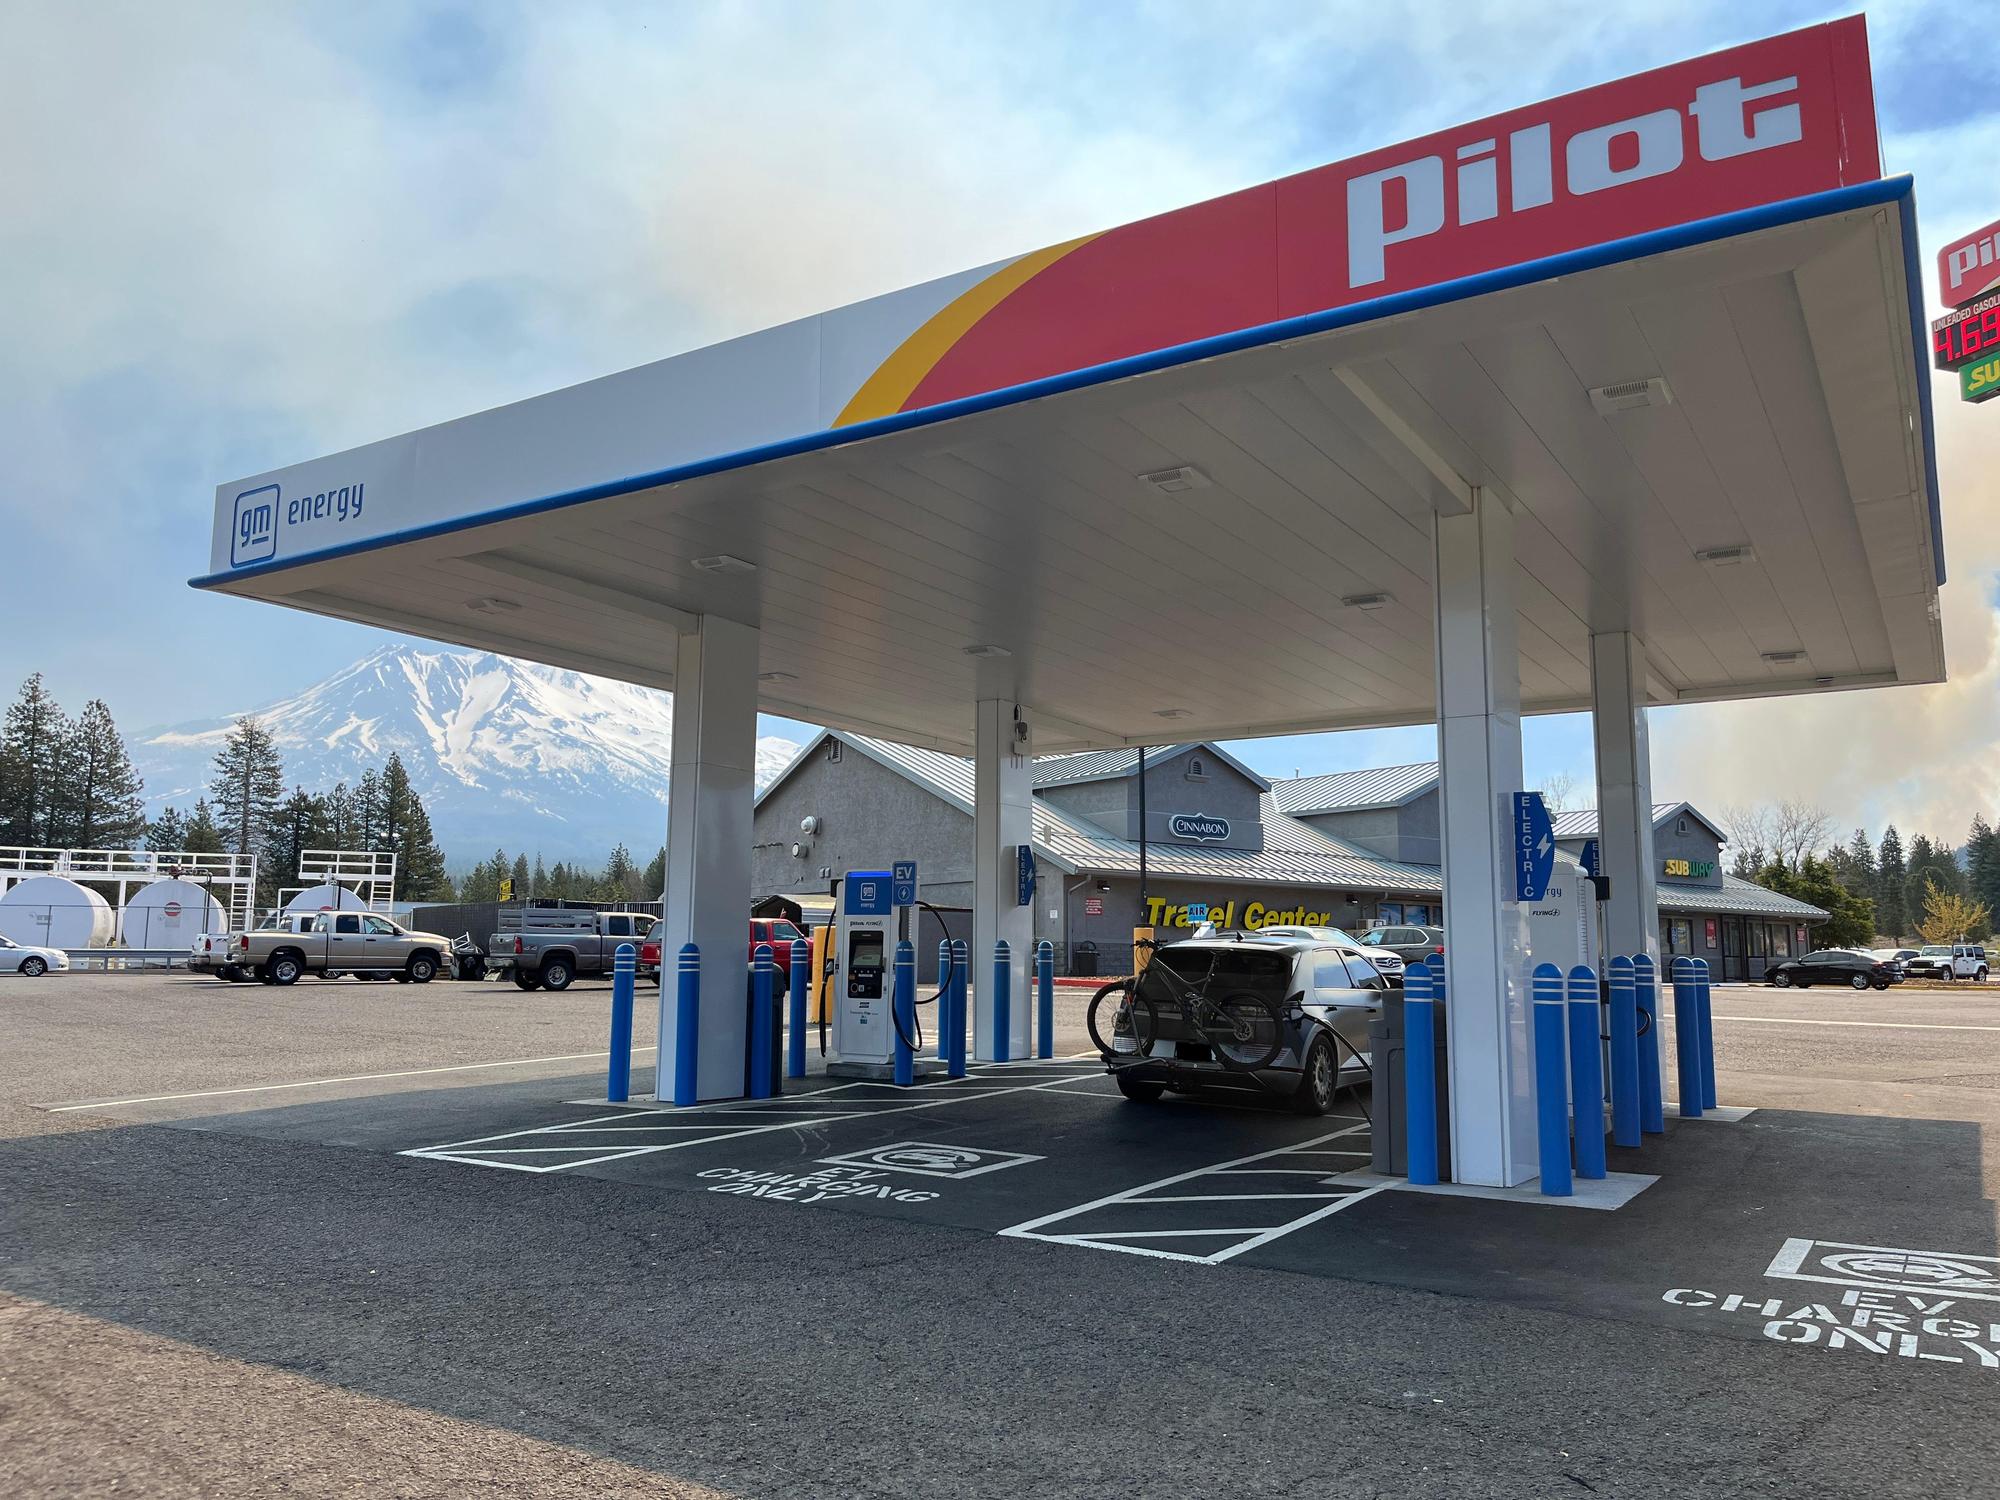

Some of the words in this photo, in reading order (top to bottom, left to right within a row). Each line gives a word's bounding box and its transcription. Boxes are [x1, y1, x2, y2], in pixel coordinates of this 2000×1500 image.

[1933, 307, 1972, 333] UNLEADED
[240, 504, 271, 548] gm
[287, 483, 365, 526] energy
[1176, 819, 1225, 835] CINNABON
[1521, 796, 1535, 898] ELECTRIC
[895, 866, 913, 880] EV
[1665, 859, 1714, 878] SUBWAY
[1188, 905, 1206, 916] AIR
[1244, 901, 1331, 930] Center
[696, 1167, 940, 1202] CHARGING
[809, 1166, 891, 1181] EV
[707, 1182, 850, 1203] ONLY
[1841, 1290, 1956, 1315] EV
